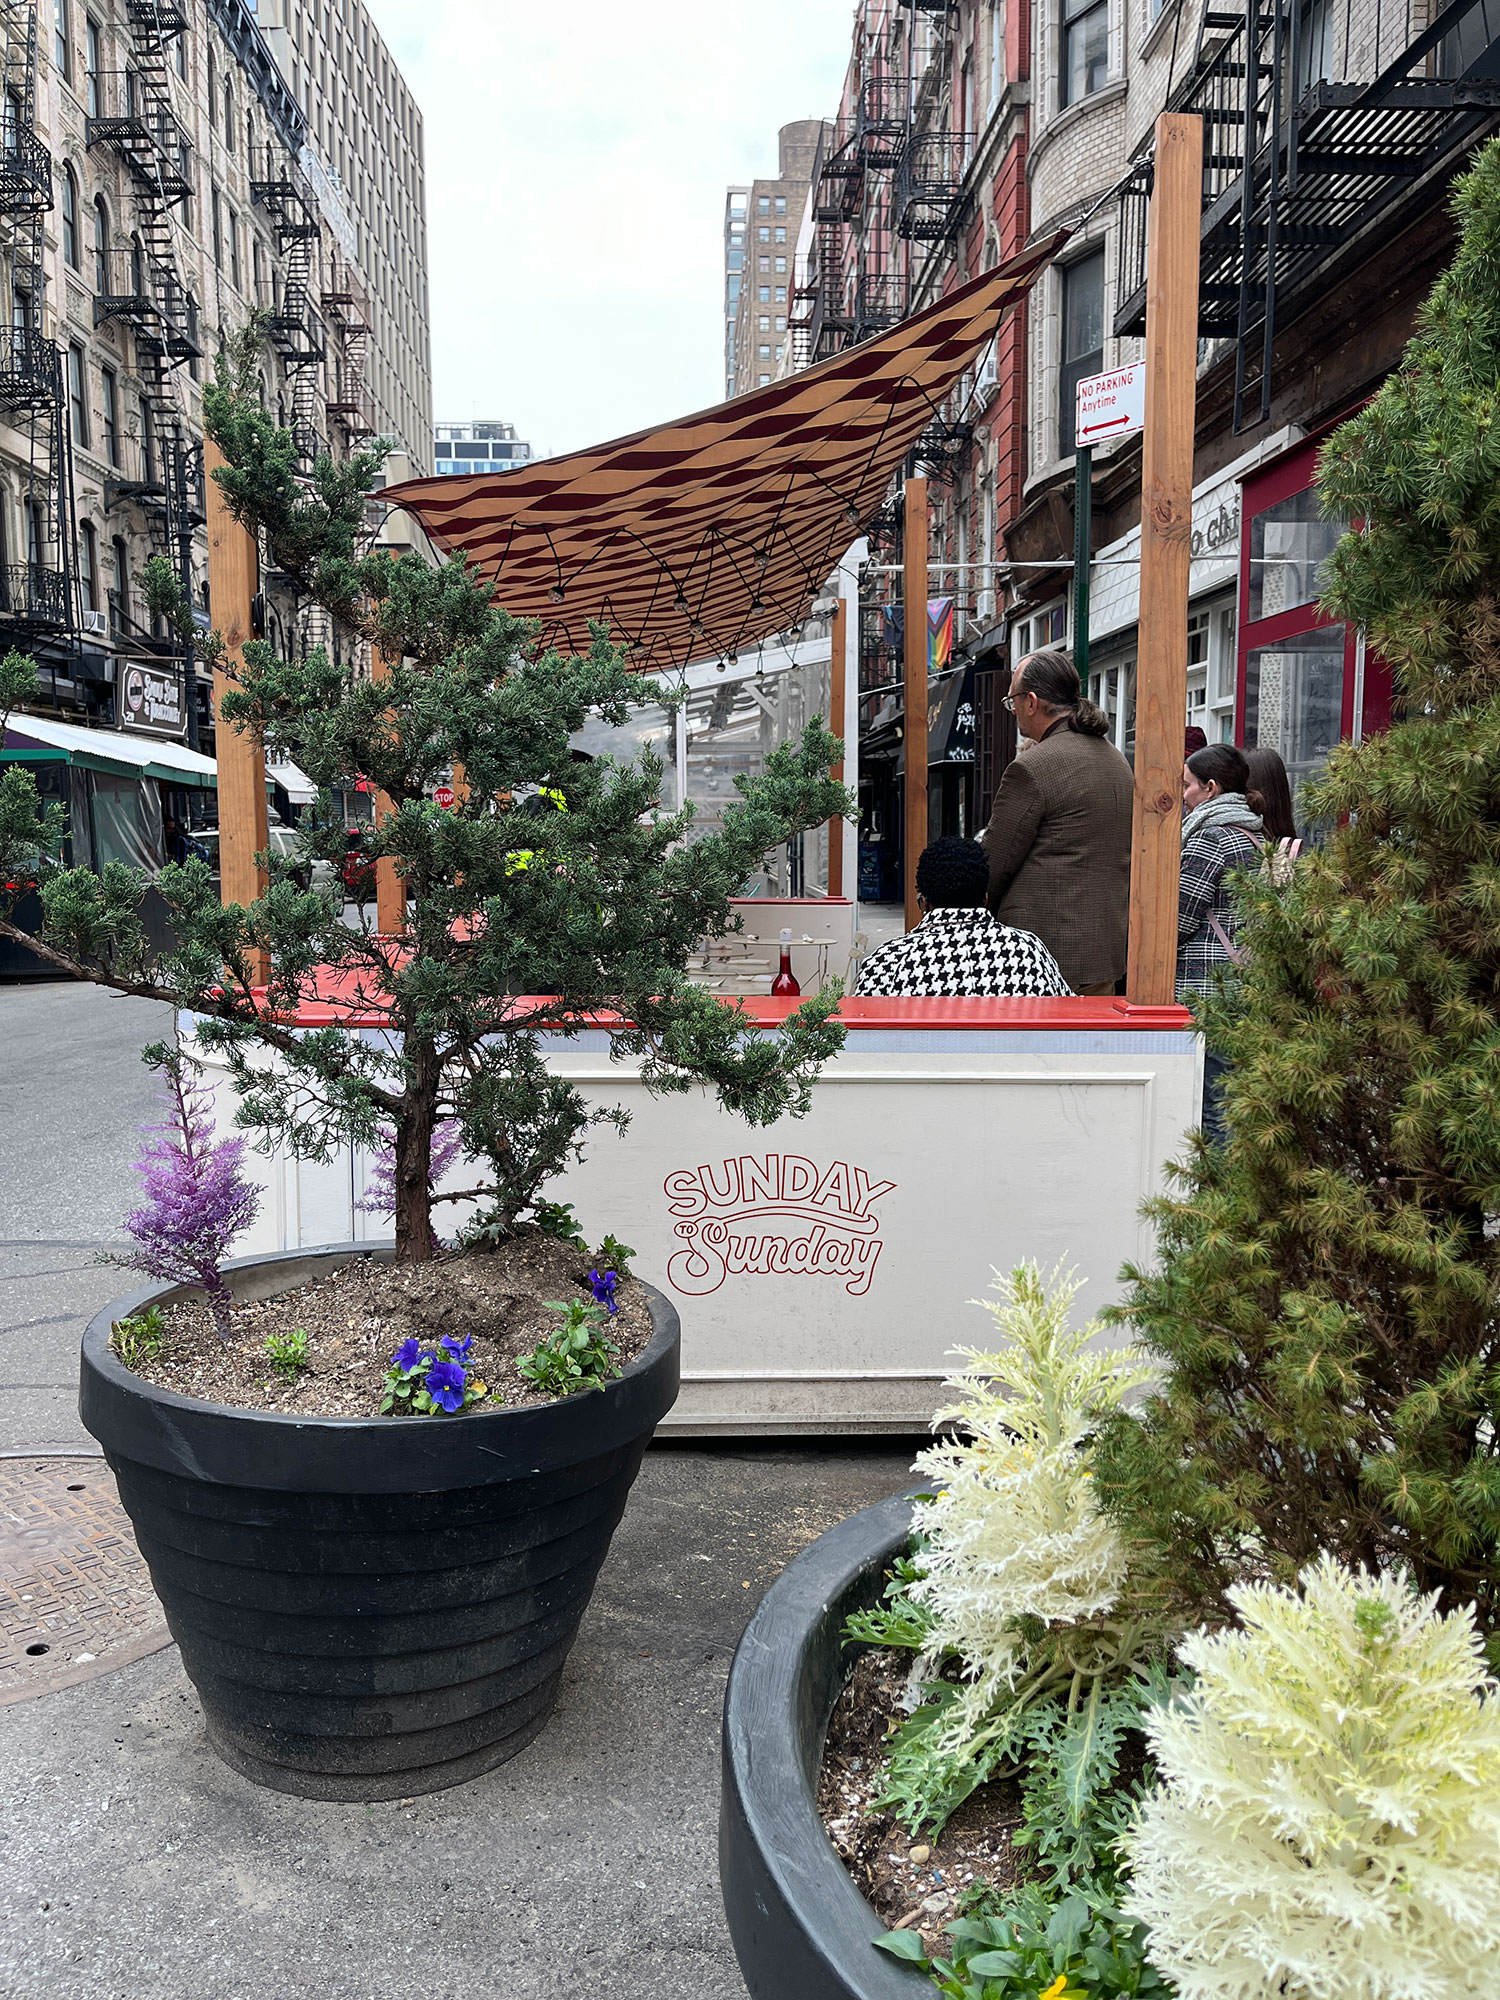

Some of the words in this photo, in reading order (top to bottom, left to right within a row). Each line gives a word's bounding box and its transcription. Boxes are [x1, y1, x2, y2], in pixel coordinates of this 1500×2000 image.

[1081, 385, 1094, 398] NO
[1096, 372, 1134, 394] PARKING
[1081, 395, 1117, 413] Anytime
[434, 792, 455, 803] STOP
[664, 1153, 898, 1218] SUNDAY
[679, 1224, 694, 1235] TO
[667, 1214, 883, 1296] Sunday
